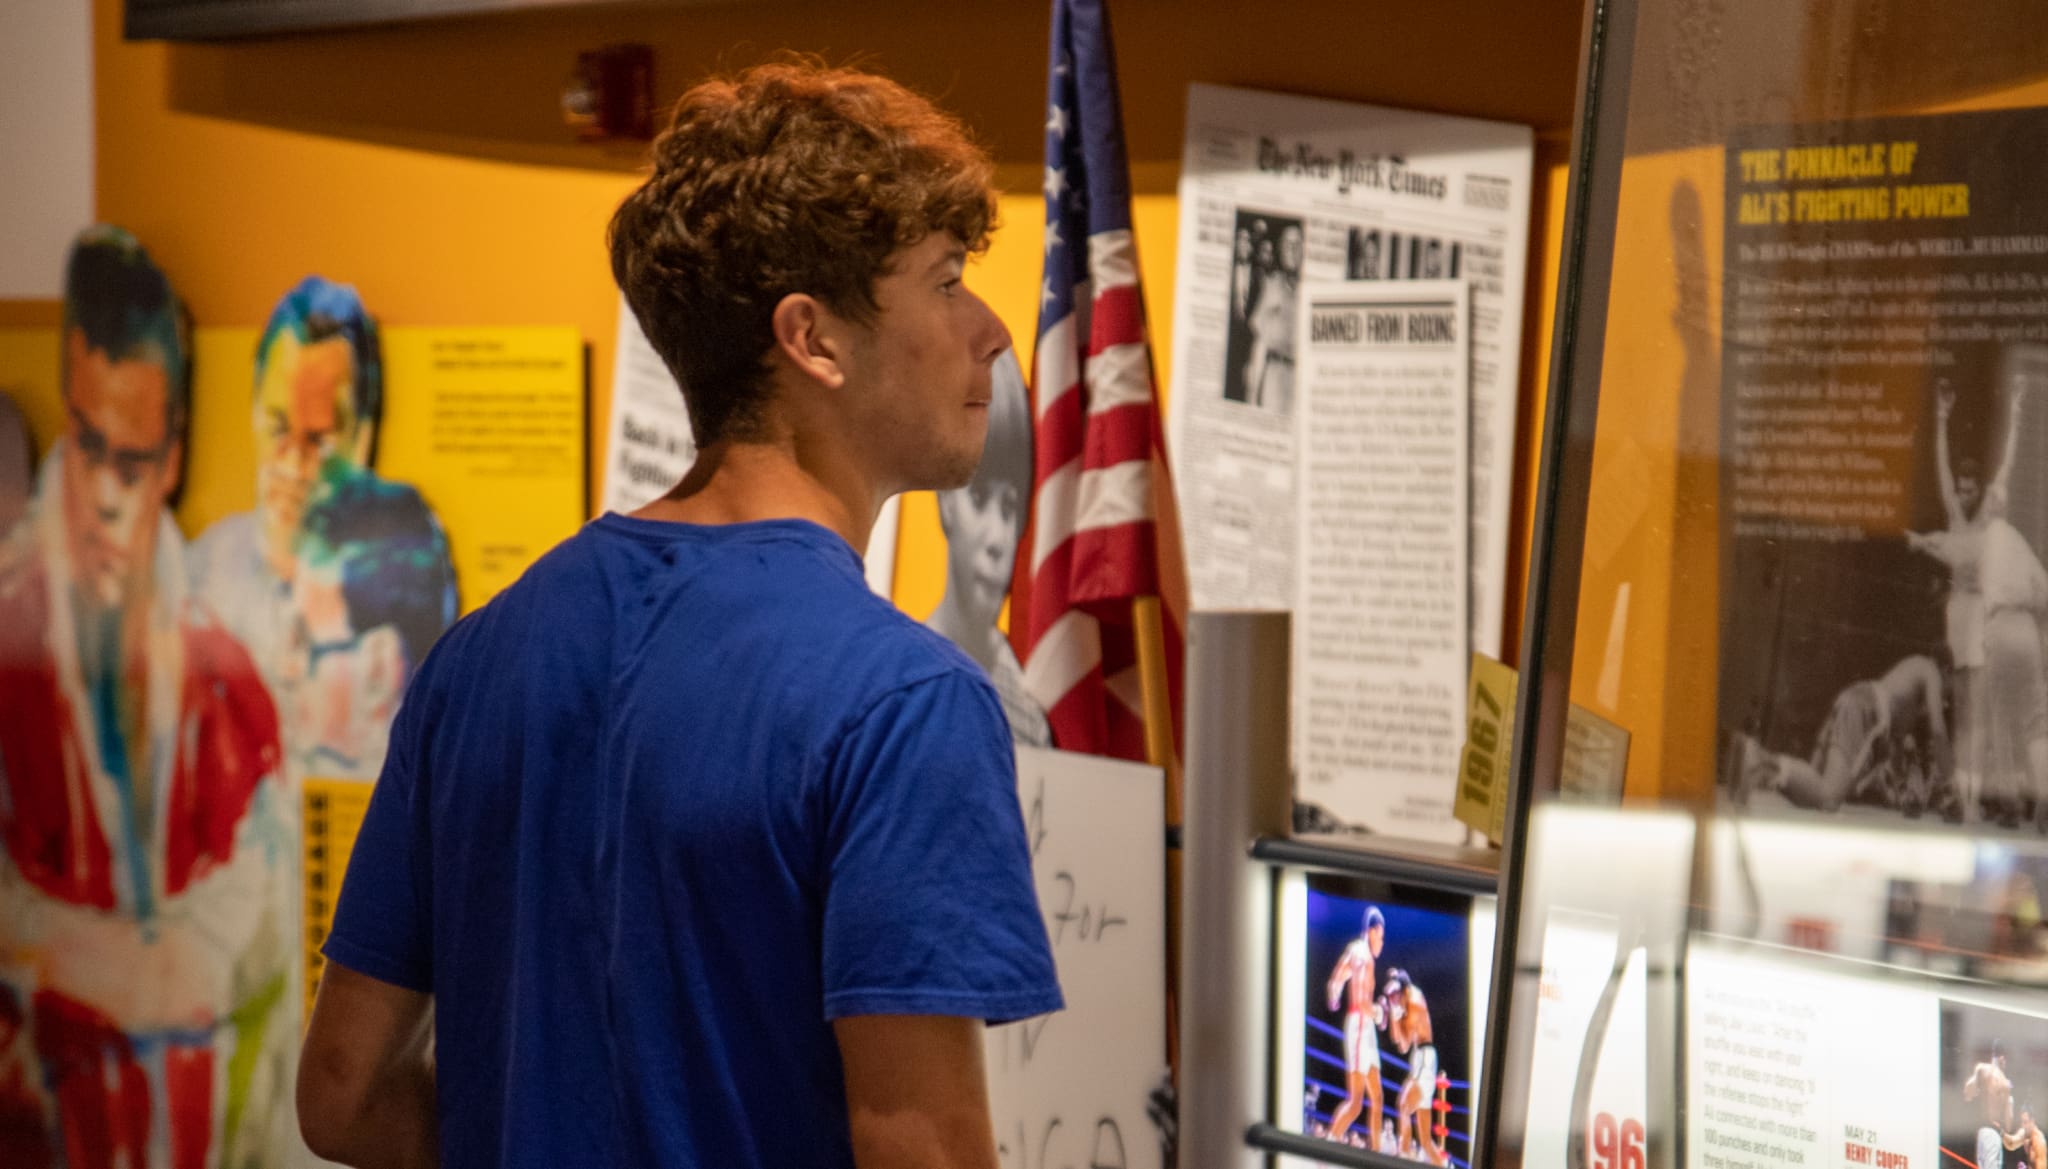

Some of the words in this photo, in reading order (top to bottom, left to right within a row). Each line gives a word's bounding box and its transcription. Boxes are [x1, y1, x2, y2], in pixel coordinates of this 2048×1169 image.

[1256, 135, 1290, 175] The
[1296, 139, 1336, 182] New
[1338, 148, 1385, 195] York
[1388, 155, 1447, 199] Times
[1739, 149, 1781, 182] THE
[1785, 143, 1886, 180] PINNACLE
[1889, 141, 1918, 175] OF
[1738, 191, 1791, 225] ALI'S
[1794, 186, 1890, 223] FIGHTING
[1895, 183, 1970, 219] POWER
[1311, 313, 1361, 343] BANNED
[1367, 313, 1404, 343] FROM
[1408, 313, 1457, 343] BOXING
[1462, 681, 1501, 806] 1967
[1719, 1133, 1752, 1153] punches
[1753, 1139, 1768, 1156] and
[1770, 1143, 1786, 1163] only
[1788, 1147, 1805, 1165] took
[1845, 1124, 1864, 1141] MAY
[1867, 1130, 1878, 1144] 21
[1845, 1142, 1872, 1165] HENRY
[1876, 1149, 1909, 1169] COOPER
